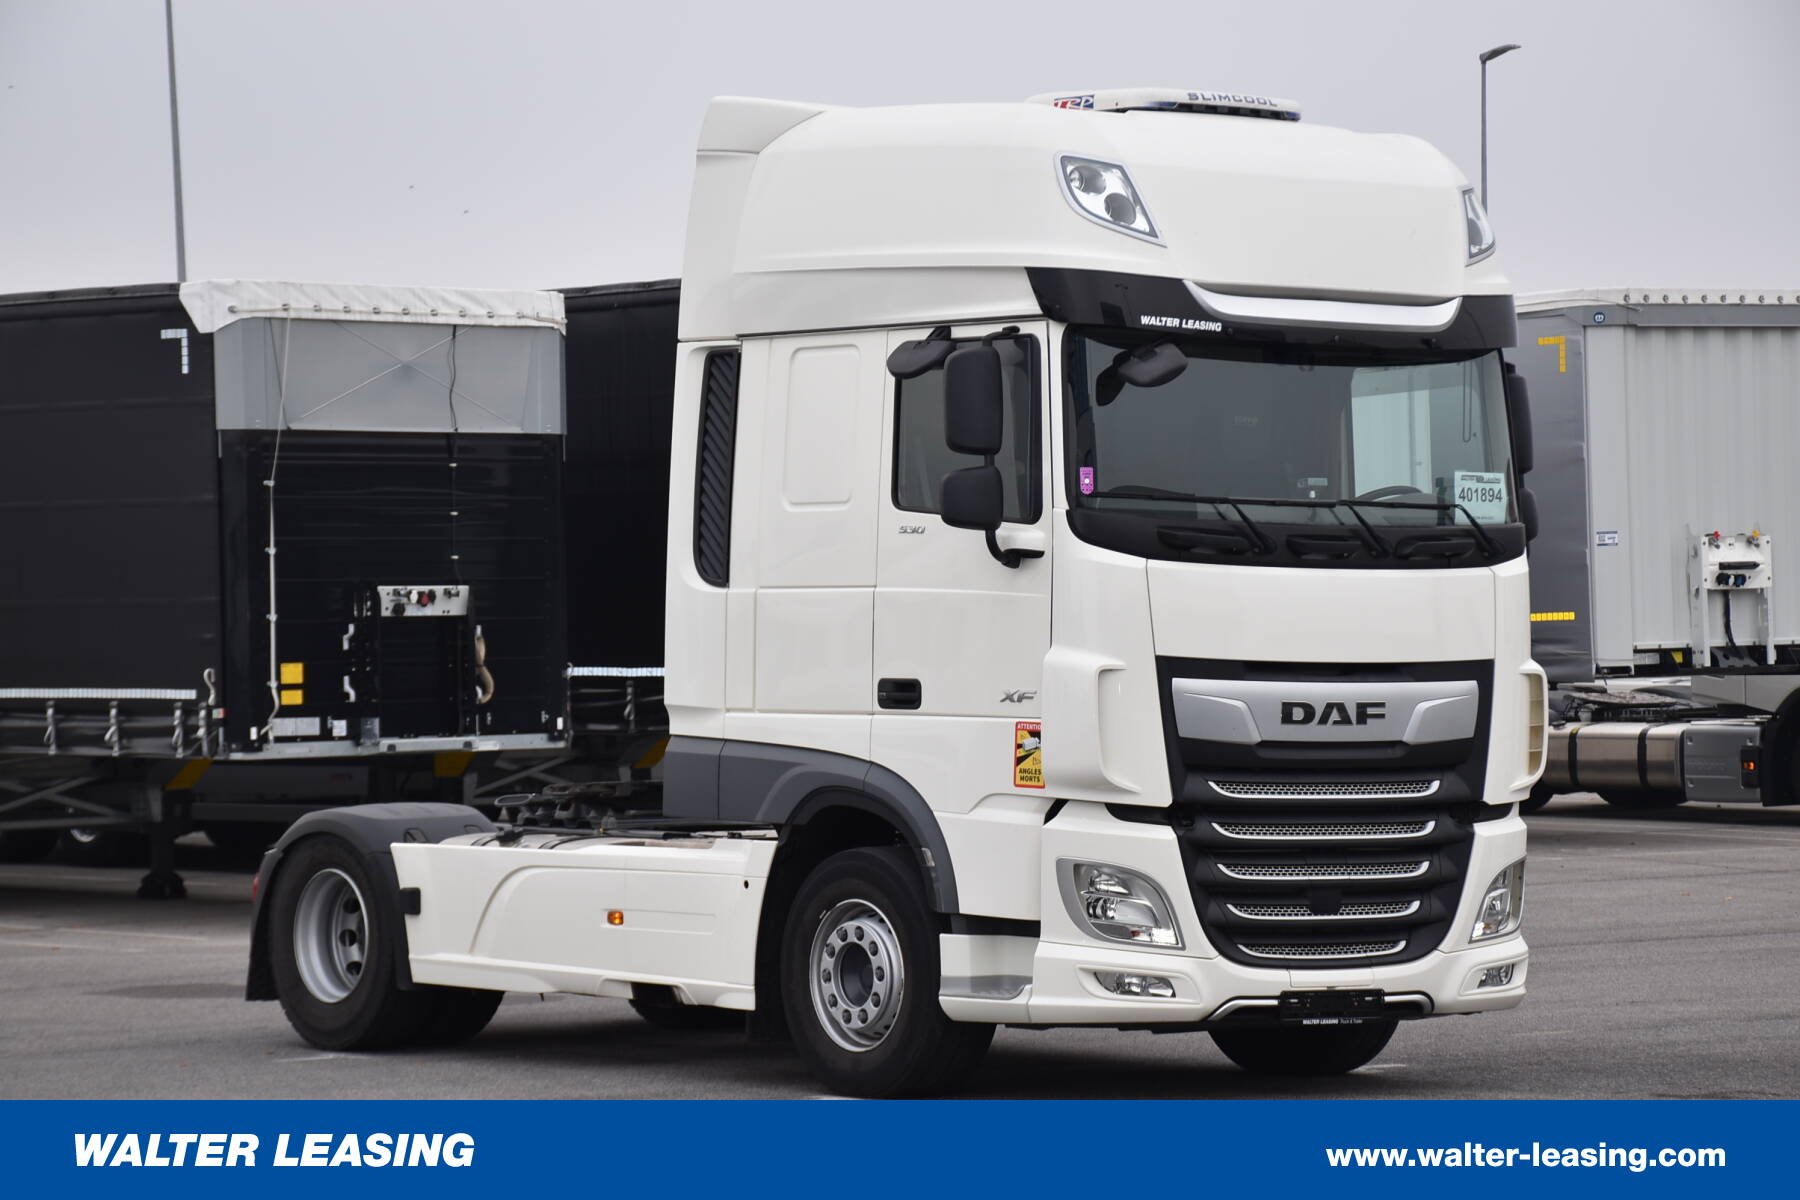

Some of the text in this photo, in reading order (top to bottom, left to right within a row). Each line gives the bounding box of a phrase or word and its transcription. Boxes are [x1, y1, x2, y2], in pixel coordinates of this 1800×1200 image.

[1054, 95, 1094, 109] TRP
[1187, 92, 1278, 107] SLIMCOOL
[1140, 315, 1222, 332] WALTER LEASING
[1458, 488, 1503, 503] 401894
[1000, 689, 1038, 703] XF
[1281, 701, 1386, 726] DAF
[1017, 723, 1041, 731] ATTENTIO
[1018, 768, 1042, 776] ANGLES
[1019, 775, 1041, 783] MORTS
